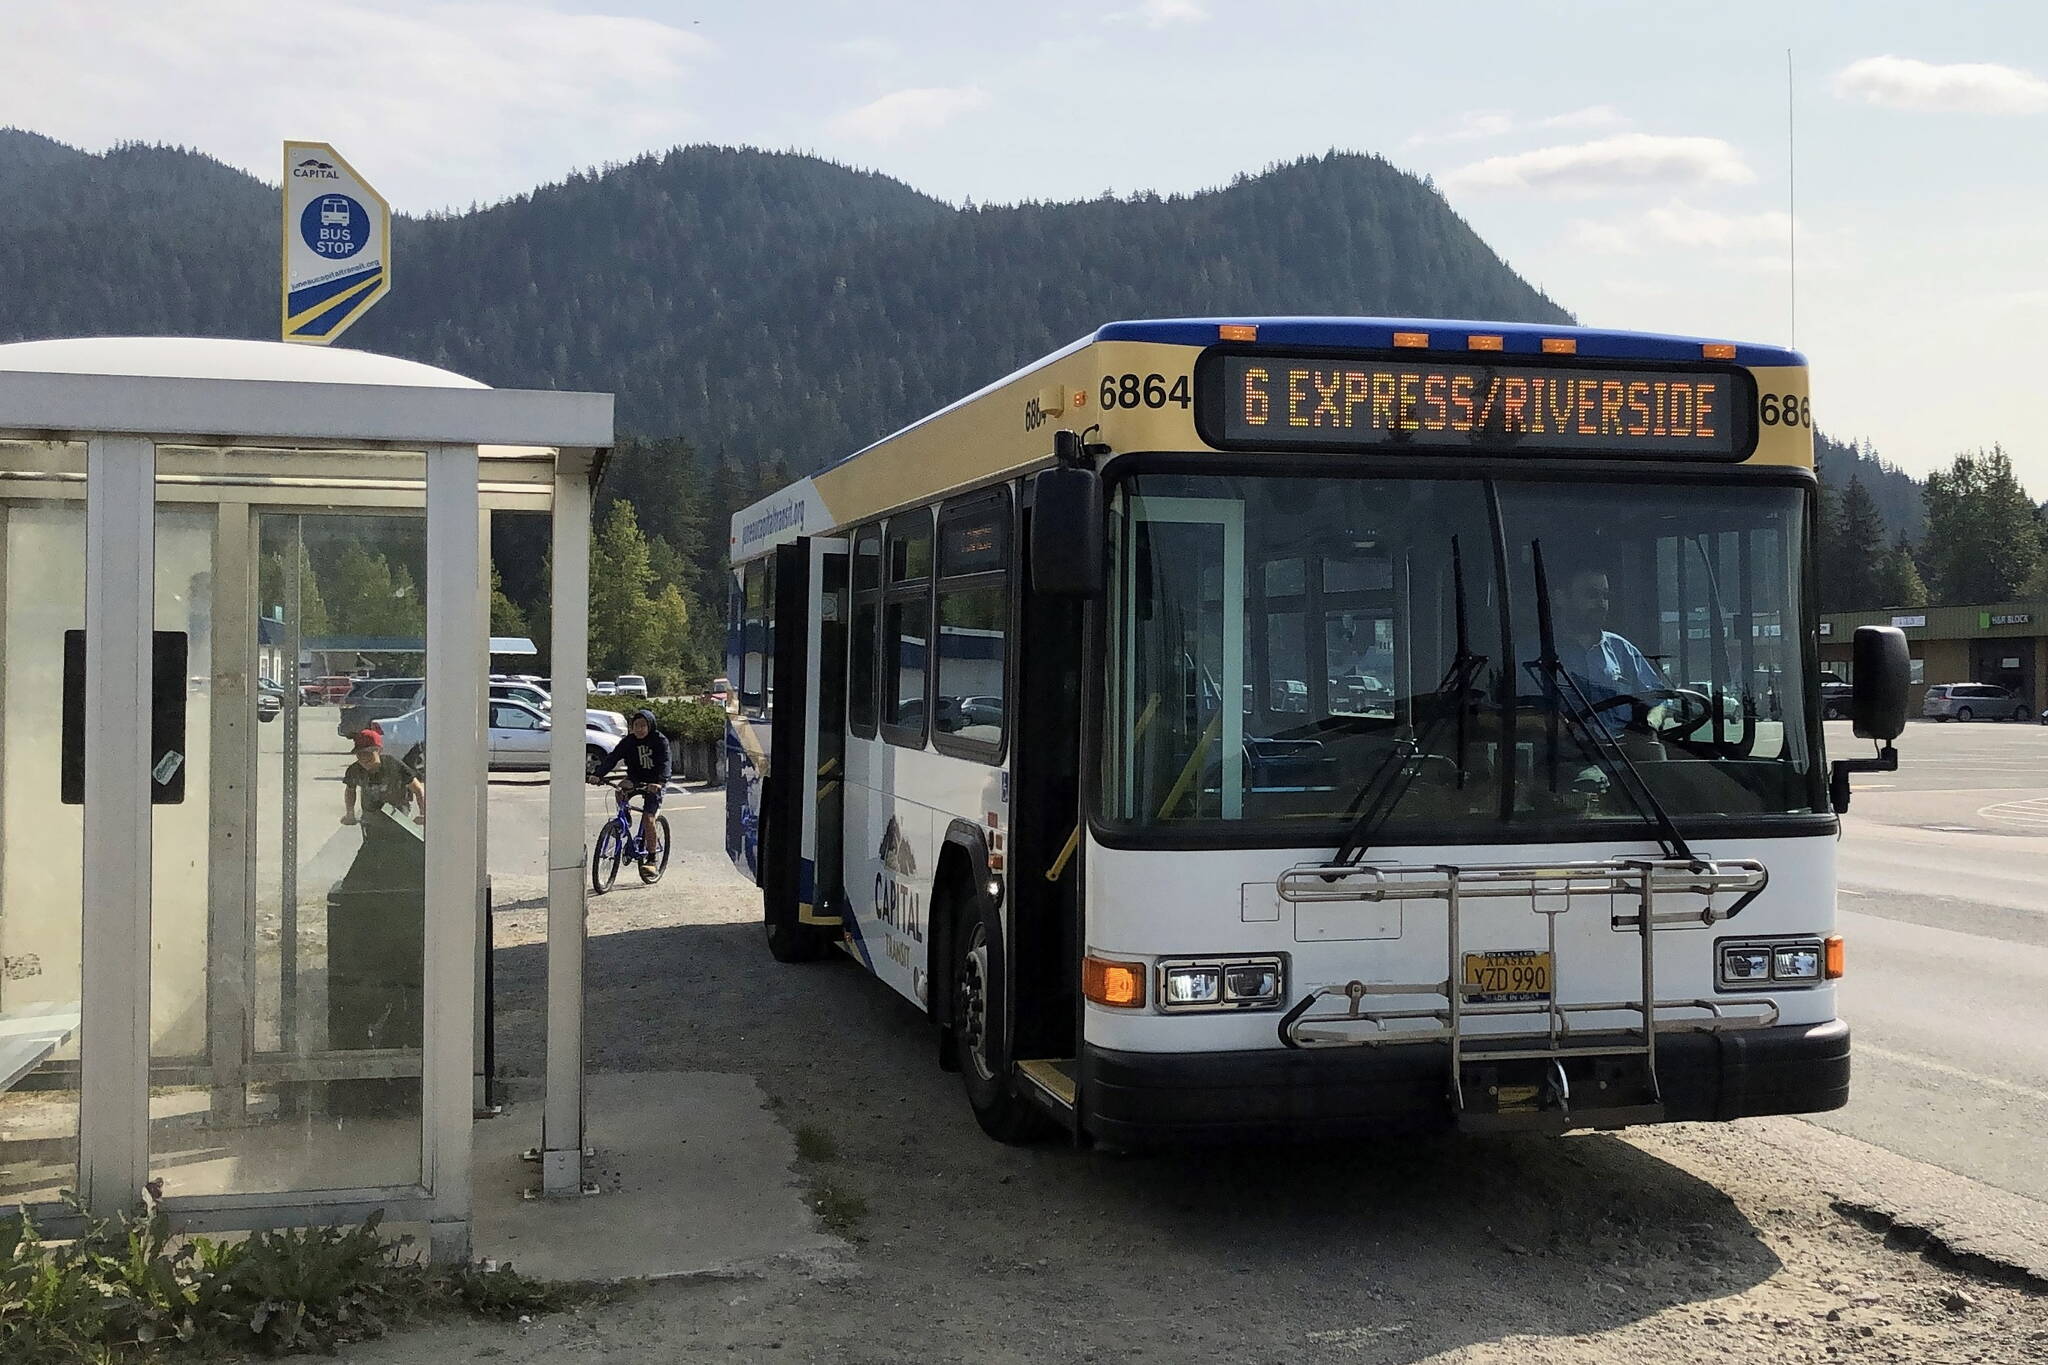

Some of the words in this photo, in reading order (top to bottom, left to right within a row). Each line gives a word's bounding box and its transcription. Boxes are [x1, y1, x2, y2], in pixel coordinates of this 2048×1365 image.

[293, 168, 339, 179] CAPITAL
[320, 228, 351, 241] BUS
[316, 241, 355, 254] STOP
[291, 258, 380, 291] juneaucapitaltransit.org
[1100, 373, 1192, 410] 6864
[1245, 368, 1269, 426] 6
[2007, 614, 2029, 624] BLOCK
[875, 872, 923, 943] CAPITAL
[1486, 957, 1534, 967] ALASKA
[1512, 966, 1546, 991] 990
